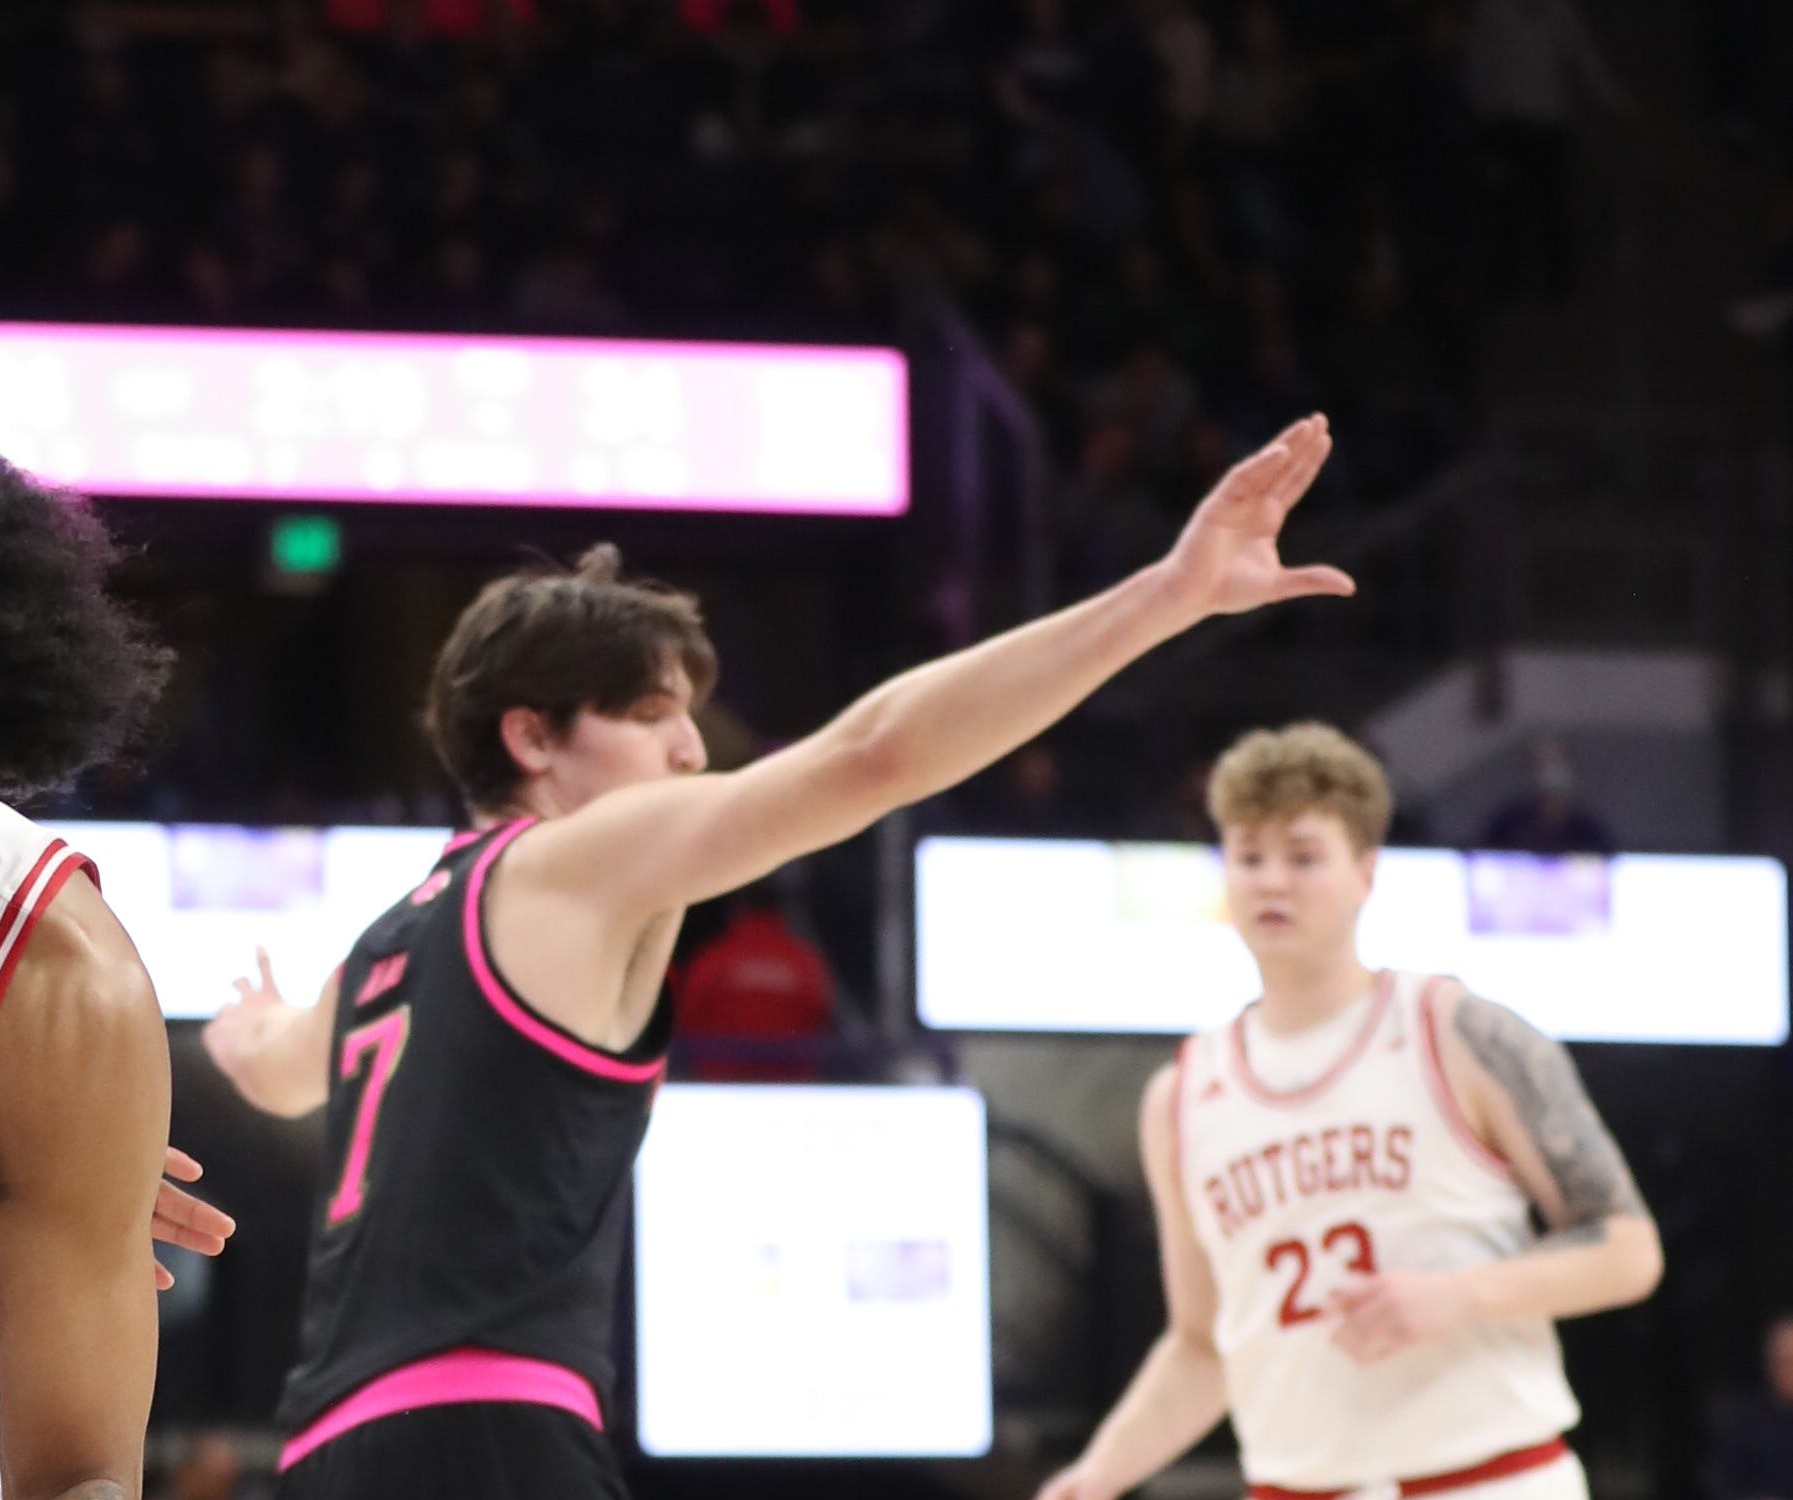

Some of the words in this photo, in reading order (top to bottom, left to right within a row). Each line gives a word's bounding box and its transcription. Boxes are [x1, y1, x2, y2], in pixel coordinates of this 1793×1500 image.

[327, 1004, 410, 1226] 7
[1204, 1123, 1413, 1240] RUTGERS
[1262, 1221, 1379, 1330] 23
